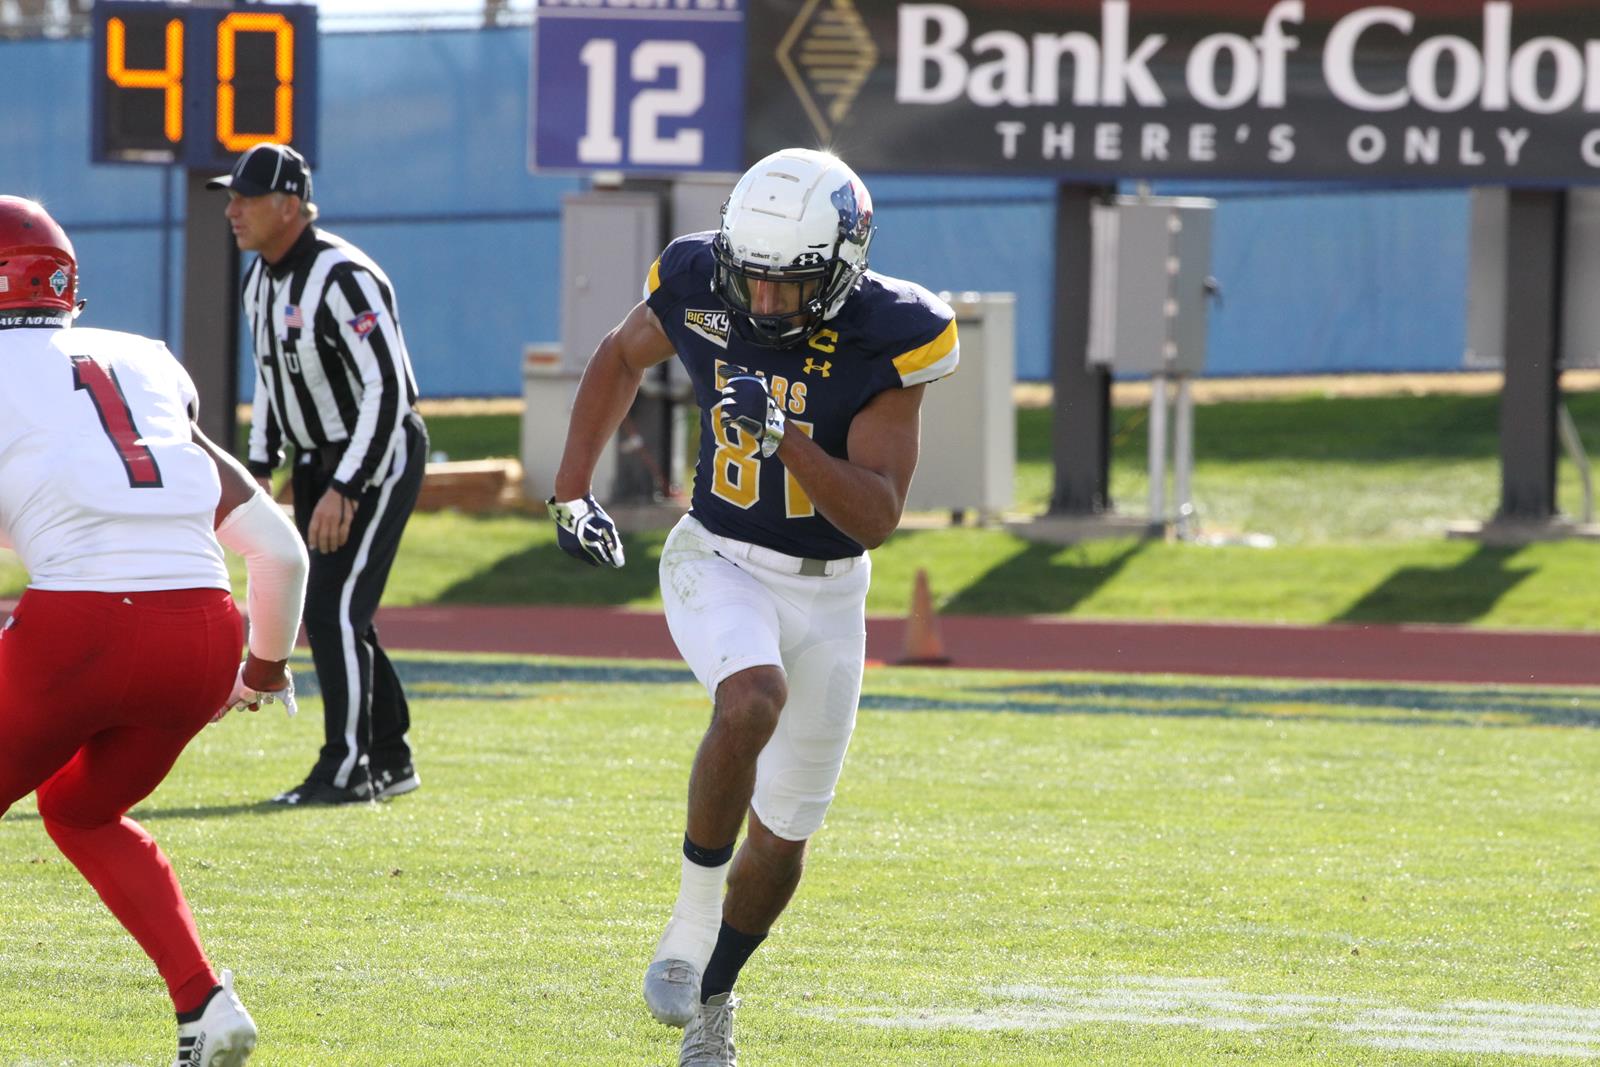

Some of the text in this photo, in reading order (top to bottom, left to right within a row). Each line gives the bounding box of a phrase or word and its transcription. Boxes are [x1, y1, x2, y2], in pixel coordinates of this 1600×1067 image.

[106, 11, 295, 153] 40
[895, 0, 1166, 108] Bank
[1186, 0, 1305, 110] of
[577, 38, 706, 166] 12
[995, 122, 1296, 164] THERE'S
[1347, 124, 1530, 167] ONLY
[25, 316, 42, 325] NO
[808, 328, 839, 354] C
[284, 351, 301, 374] U
[70, 354, 164, 489] 1
